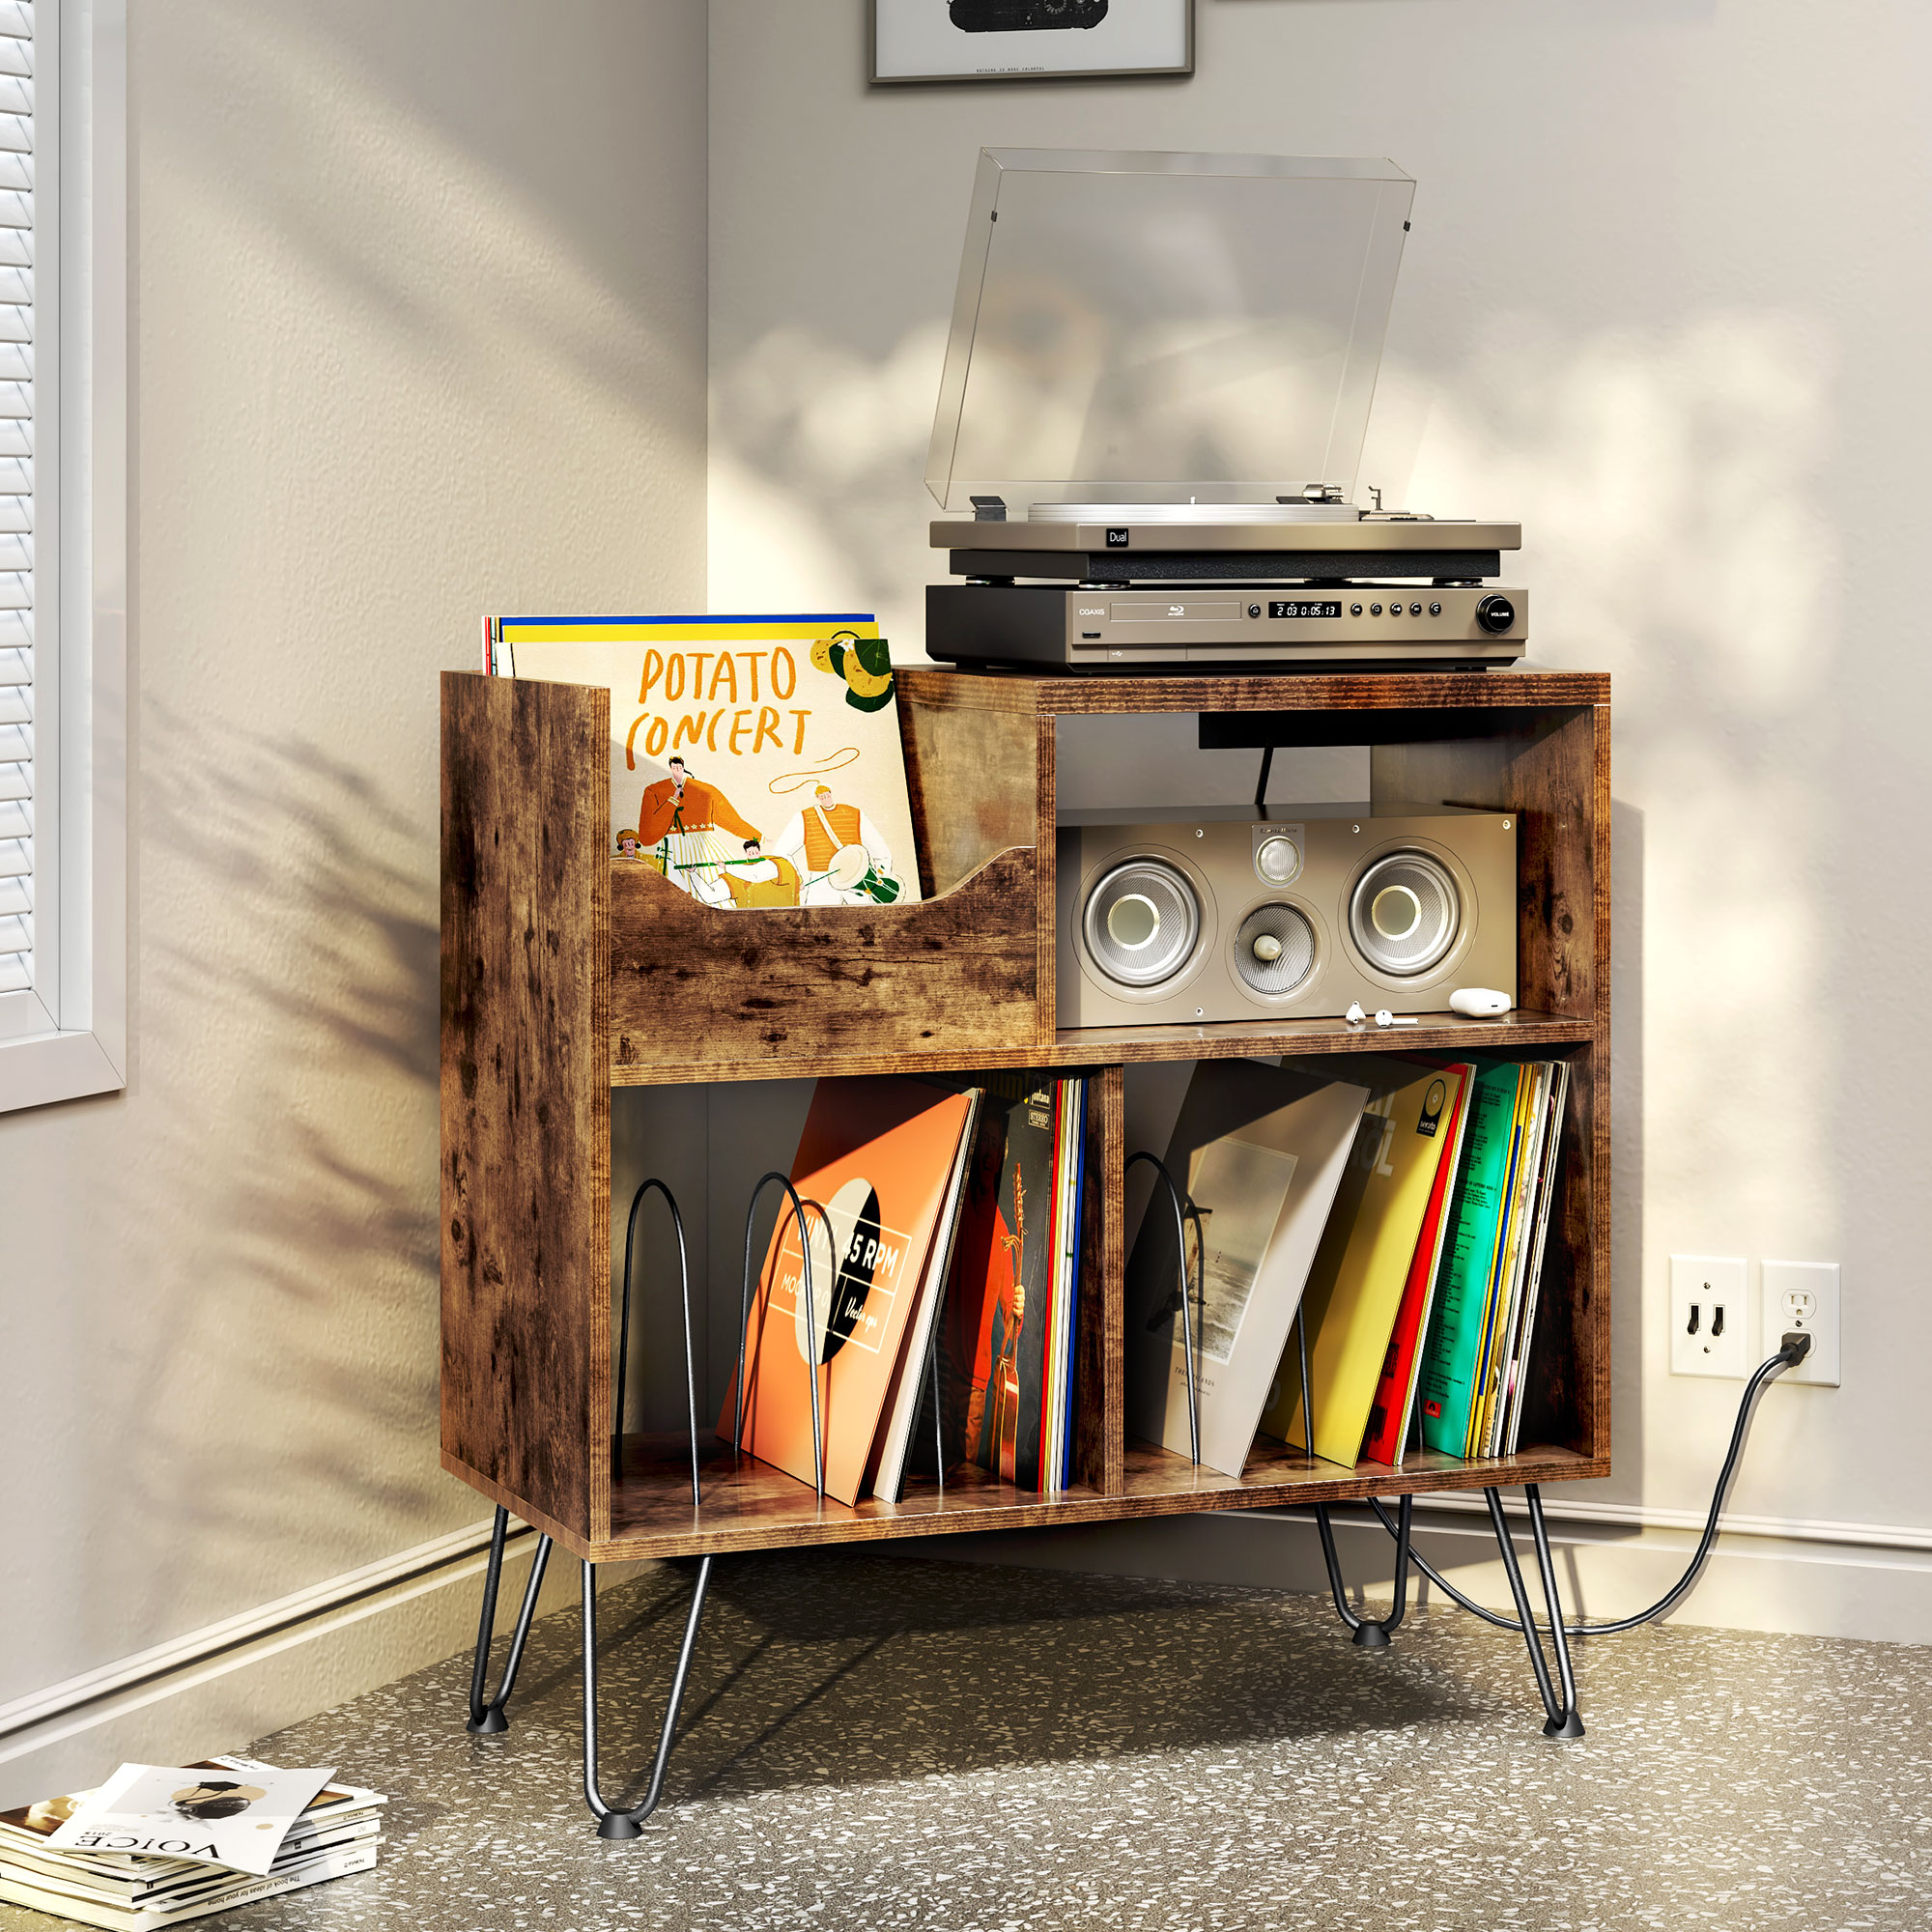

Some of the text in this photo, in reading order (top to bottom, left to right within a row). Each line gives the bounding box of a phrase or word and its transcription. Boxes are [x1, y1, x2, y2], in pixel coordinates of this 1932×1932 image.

[1109, 531, 1127, 542] Dual
[1277, 606, 1284, 616] 2
[1287, 606, 1297, 616] 03
[638, 645, 797, 705] POTATO
[625, 706, 812, 771] CONCERT
[842, 1230, 865, 1264] 45
[862, 1237, 899, 1278] RPM
[273, 1878, 289, 1888] book
[240, 1889, 249, 1898] for
[249, 1885, 266, 1894] ideas
[208, 1896, 225, 1906] home
[225, 1891, 240, 1901] your
